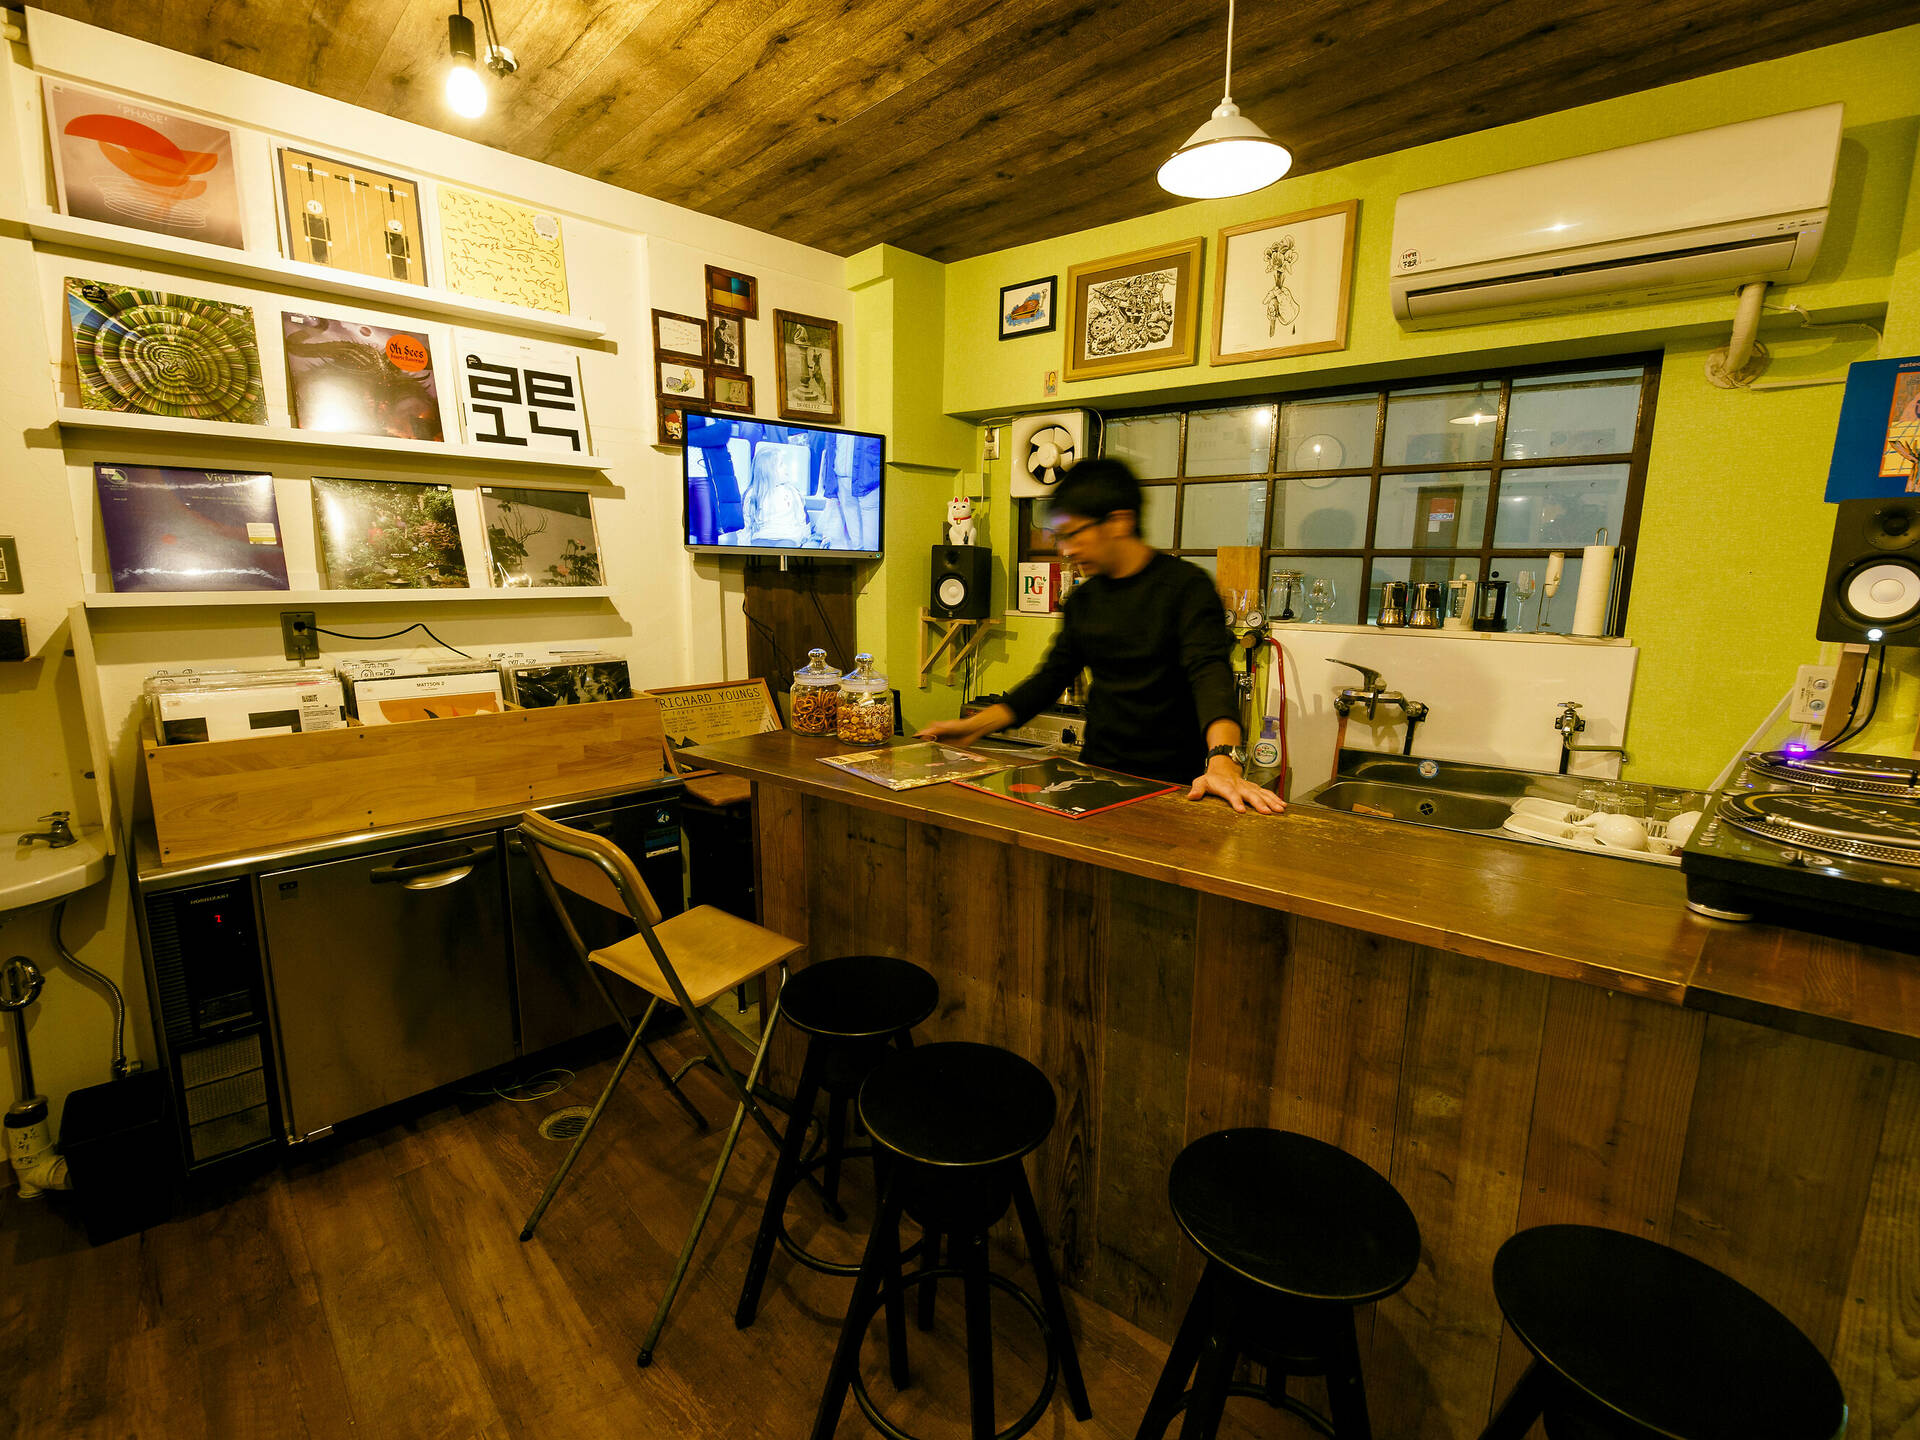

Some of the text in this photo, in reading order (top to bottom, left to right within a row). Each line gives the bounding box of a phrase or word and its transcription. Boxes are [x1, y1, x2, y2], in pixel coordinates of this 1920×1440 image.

[390, 343, 402, 355] Oh
[404, 345, 424, 359] Sees
[205, 473, 230, 483] Vive
[1024, 576, 1043, 595] PG
[660, 687, 760, 709] RICHARD YOUNGS
